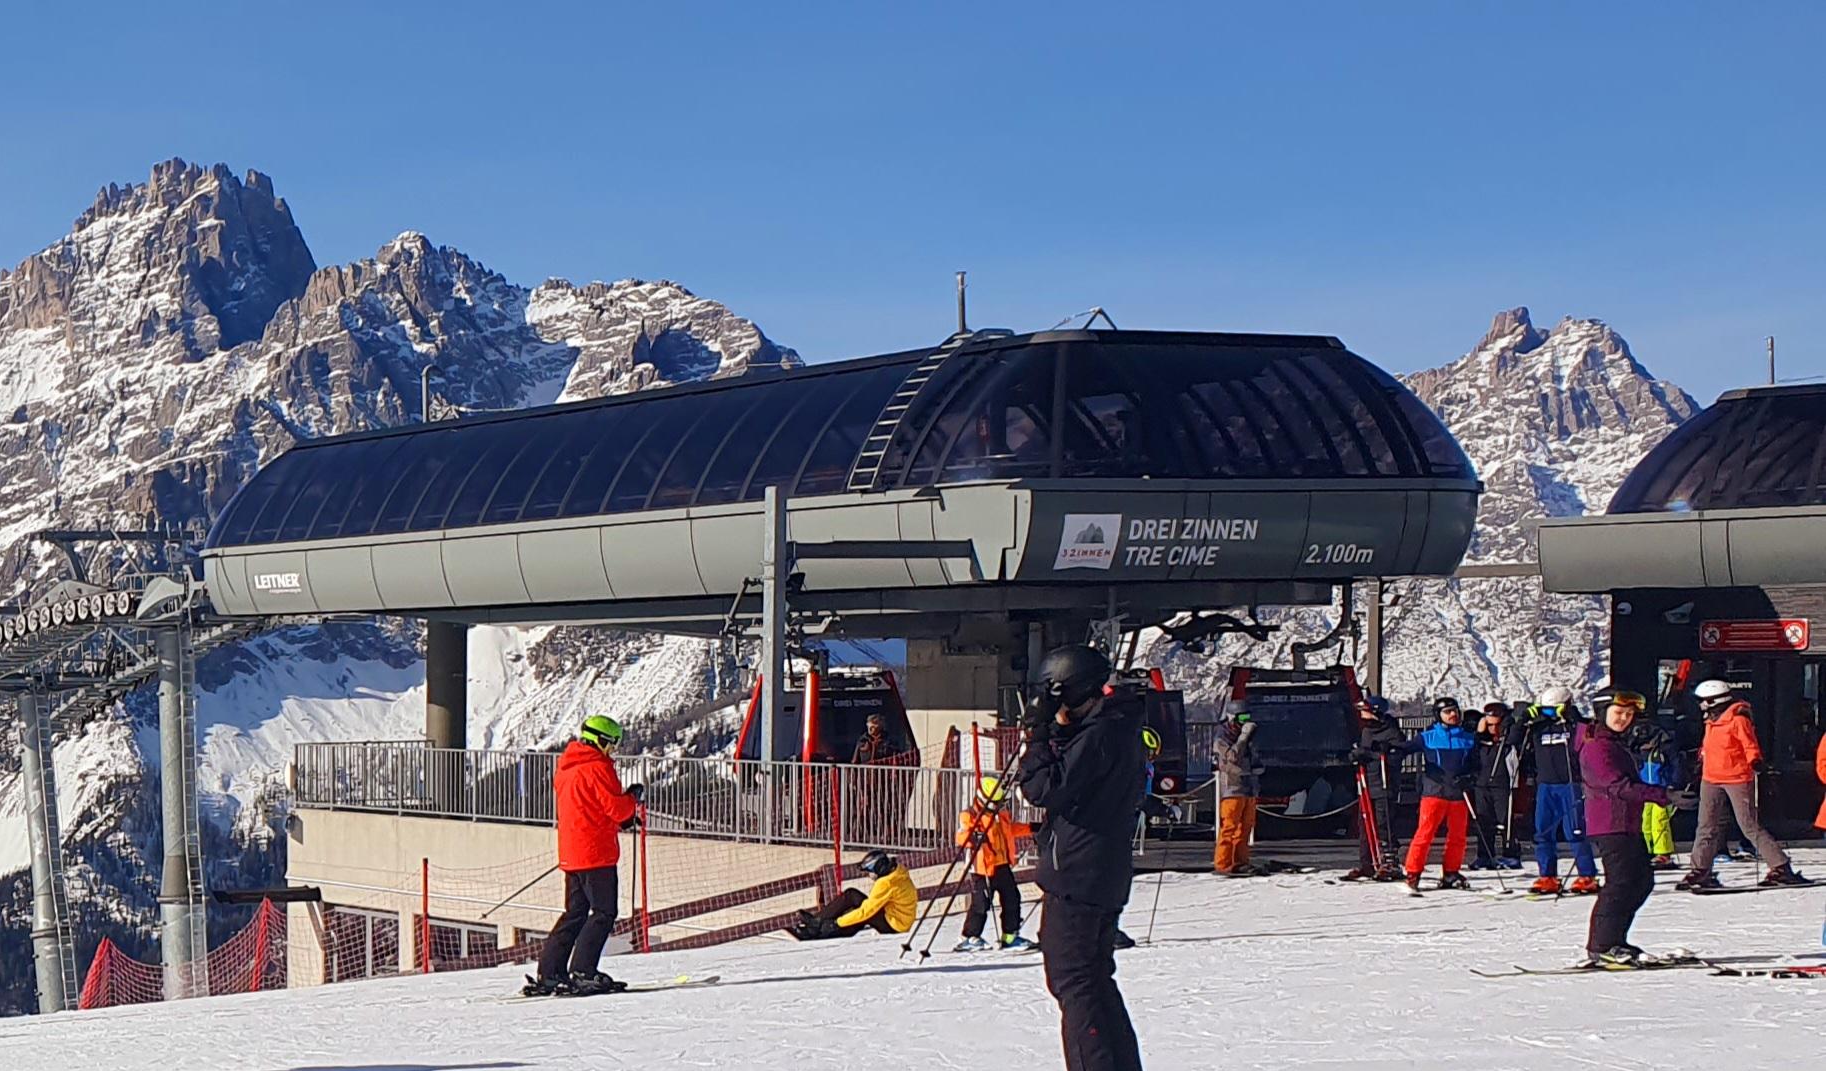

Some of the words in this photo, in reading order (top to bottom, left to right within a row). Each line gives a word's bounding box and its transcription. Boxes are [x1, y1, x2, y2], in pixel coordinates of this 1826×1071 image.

[1128, 519, 1177, 540] DREI
[1180, 519, 1259, 540] ZINNEN
[1125, 546, 1165, 566] TRE
[1167, 546, 1220, 566] CIME
[1305, 544, 1374, 563] 2.100m
[254, 573, 300, 589] LEITNER
